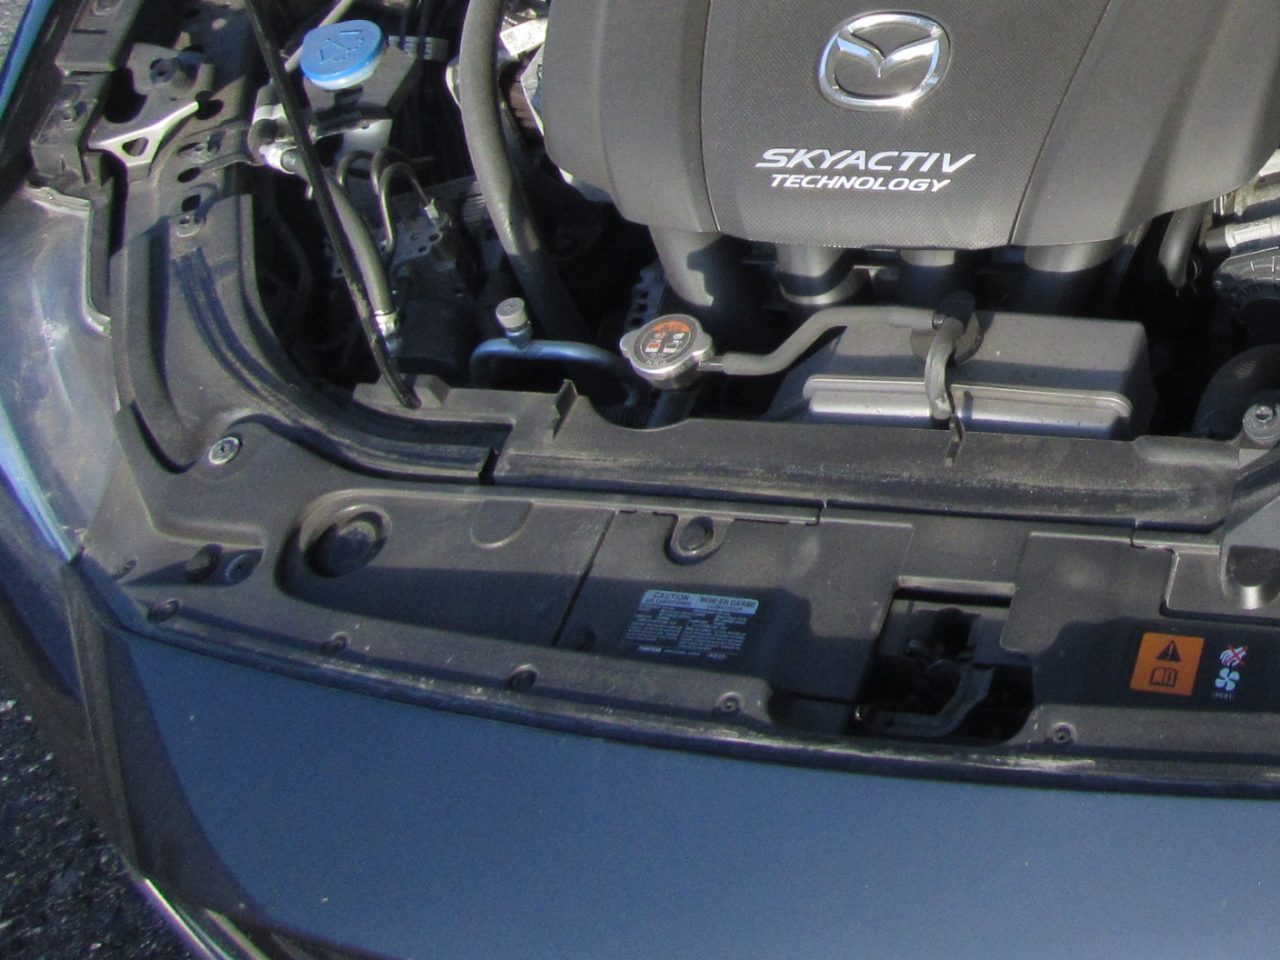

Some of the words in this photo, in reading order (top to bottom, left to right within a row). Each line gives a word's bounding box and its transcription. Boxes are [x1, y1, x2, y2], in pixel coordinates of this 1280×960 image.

[755, 148, 976, 173] SKYACTIV
[770, 174, 952, 193] TECHNOLOGY
[653, 591, 690, 602] CAUTION
